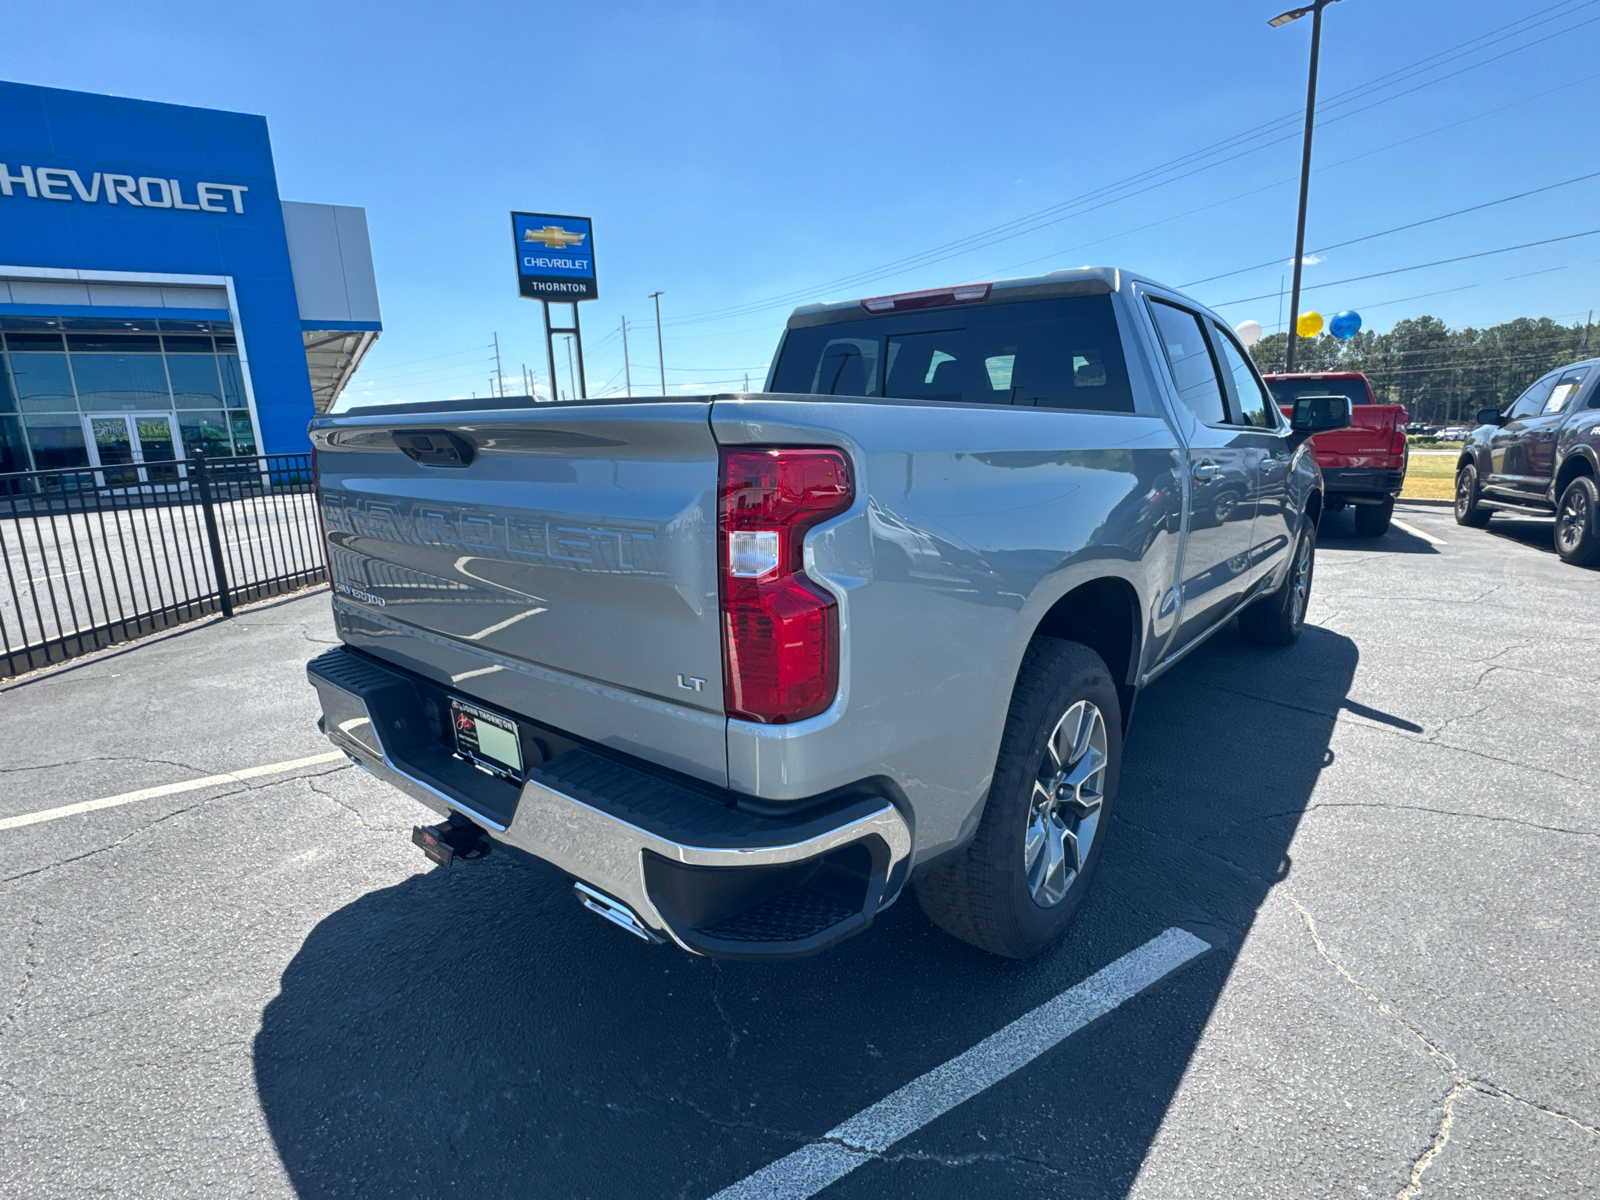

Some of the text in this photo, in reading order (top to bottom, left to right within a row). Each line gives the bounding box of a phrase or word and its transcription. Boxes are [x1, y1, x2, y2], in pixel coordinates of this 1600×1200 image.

[0, 163, 248, 214] HEVROLET
[523, 256, 589, 270] CHEVROLET
[531, 281, 587, 293] THORNTON
[323, 493, 655, 570] CHEVROLET
[676, 673, 707, 692] LT
